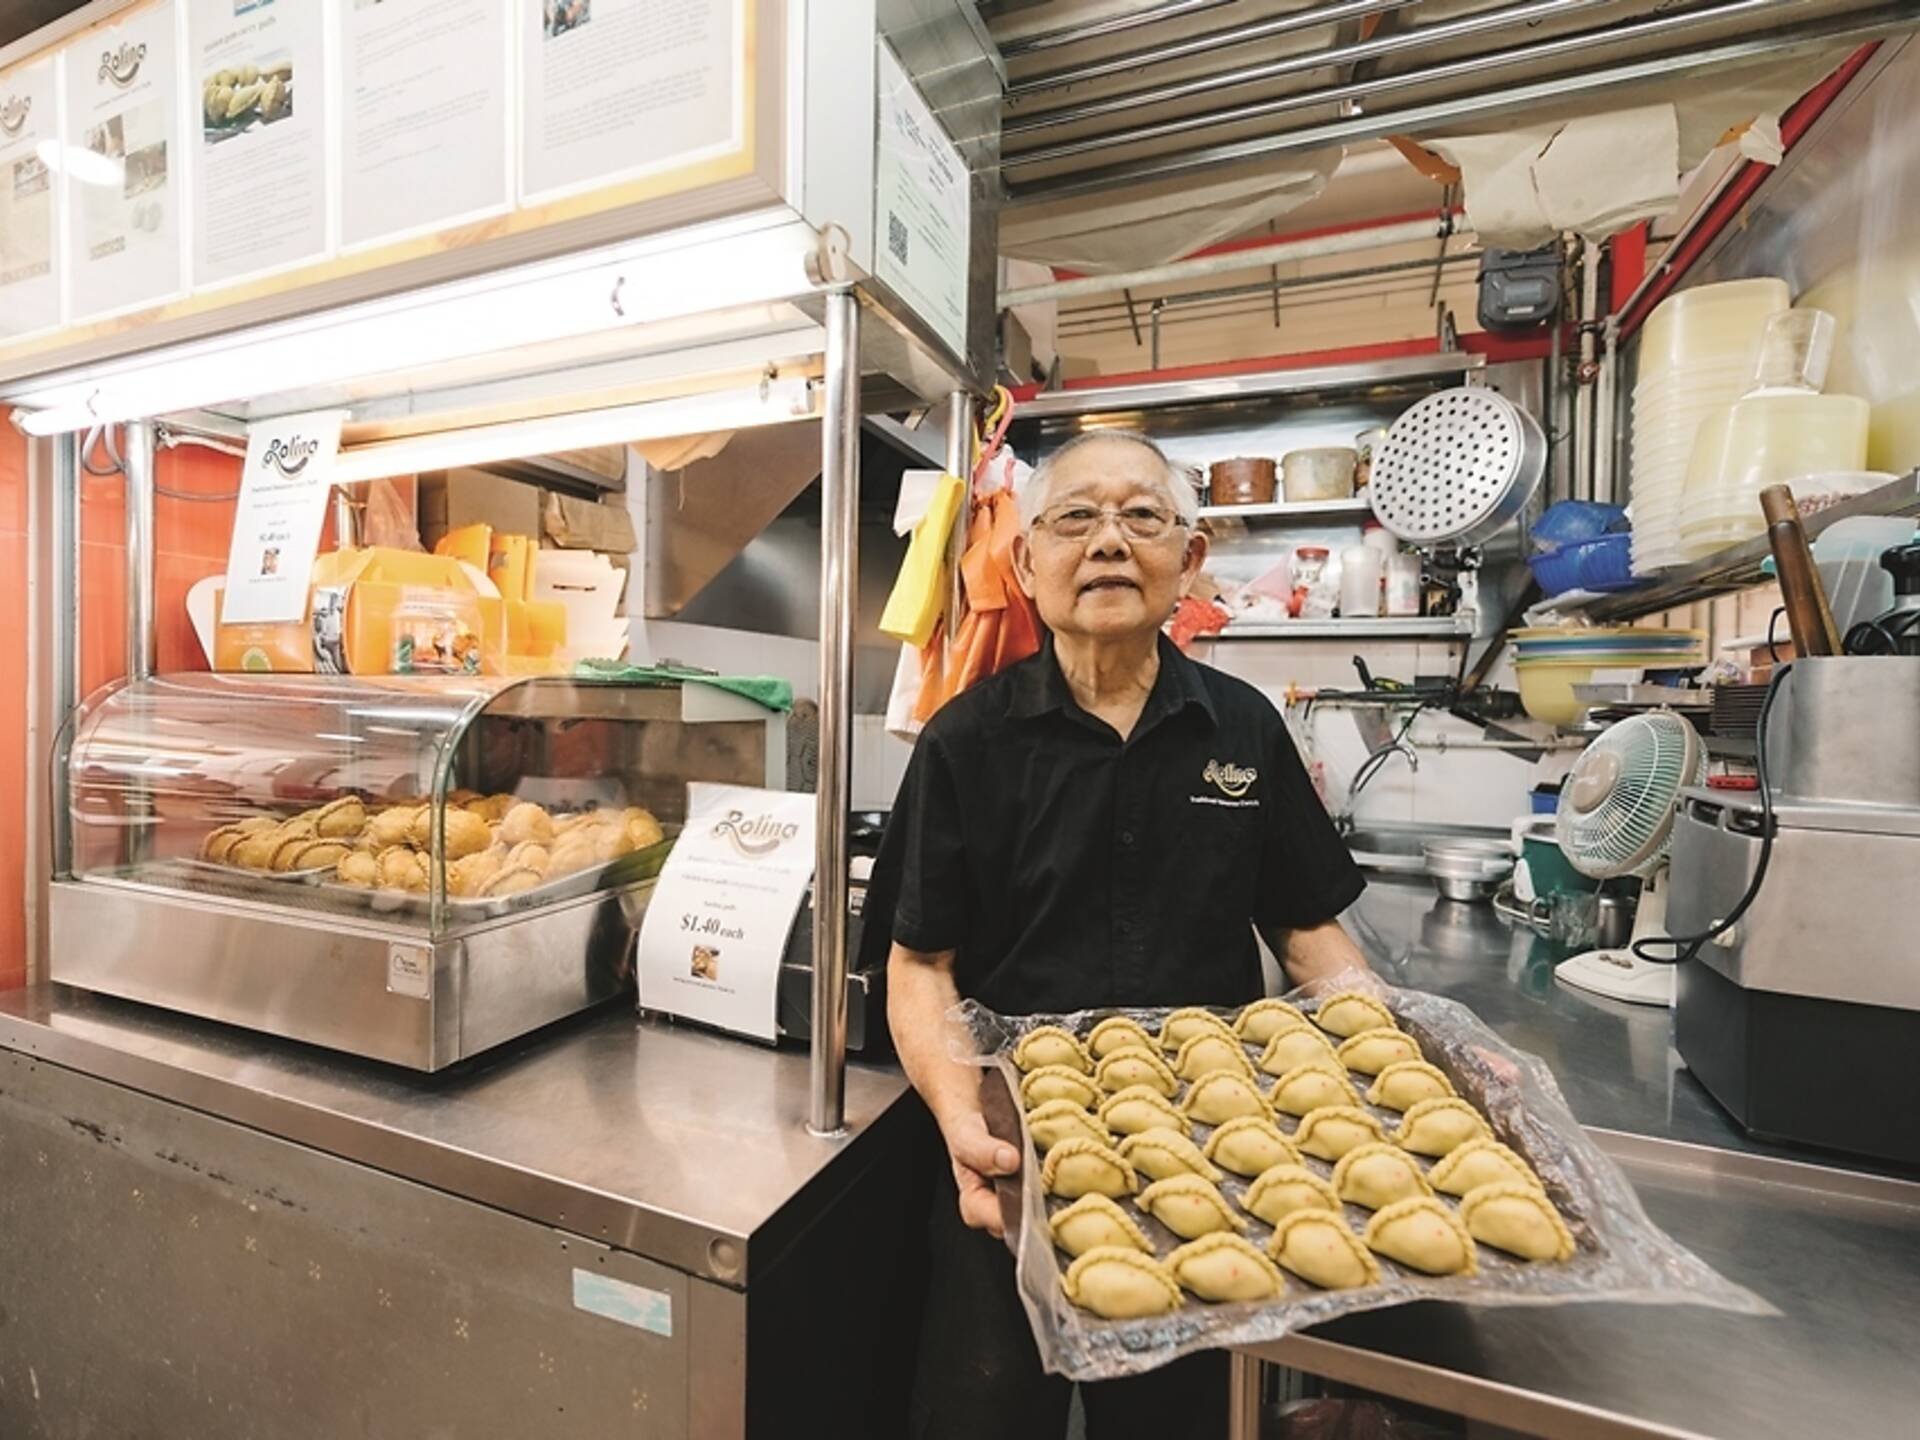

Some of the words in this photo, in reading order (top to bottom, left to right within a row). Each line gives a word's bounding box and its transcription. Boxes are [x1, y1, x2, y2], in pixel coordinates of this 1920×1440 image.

[262, 434, 319, 477] Rolina
[713, 810, 799, 856] Rolina
[680, 912, 721, 935] $1.40
[720, 926, 744, 940] each
